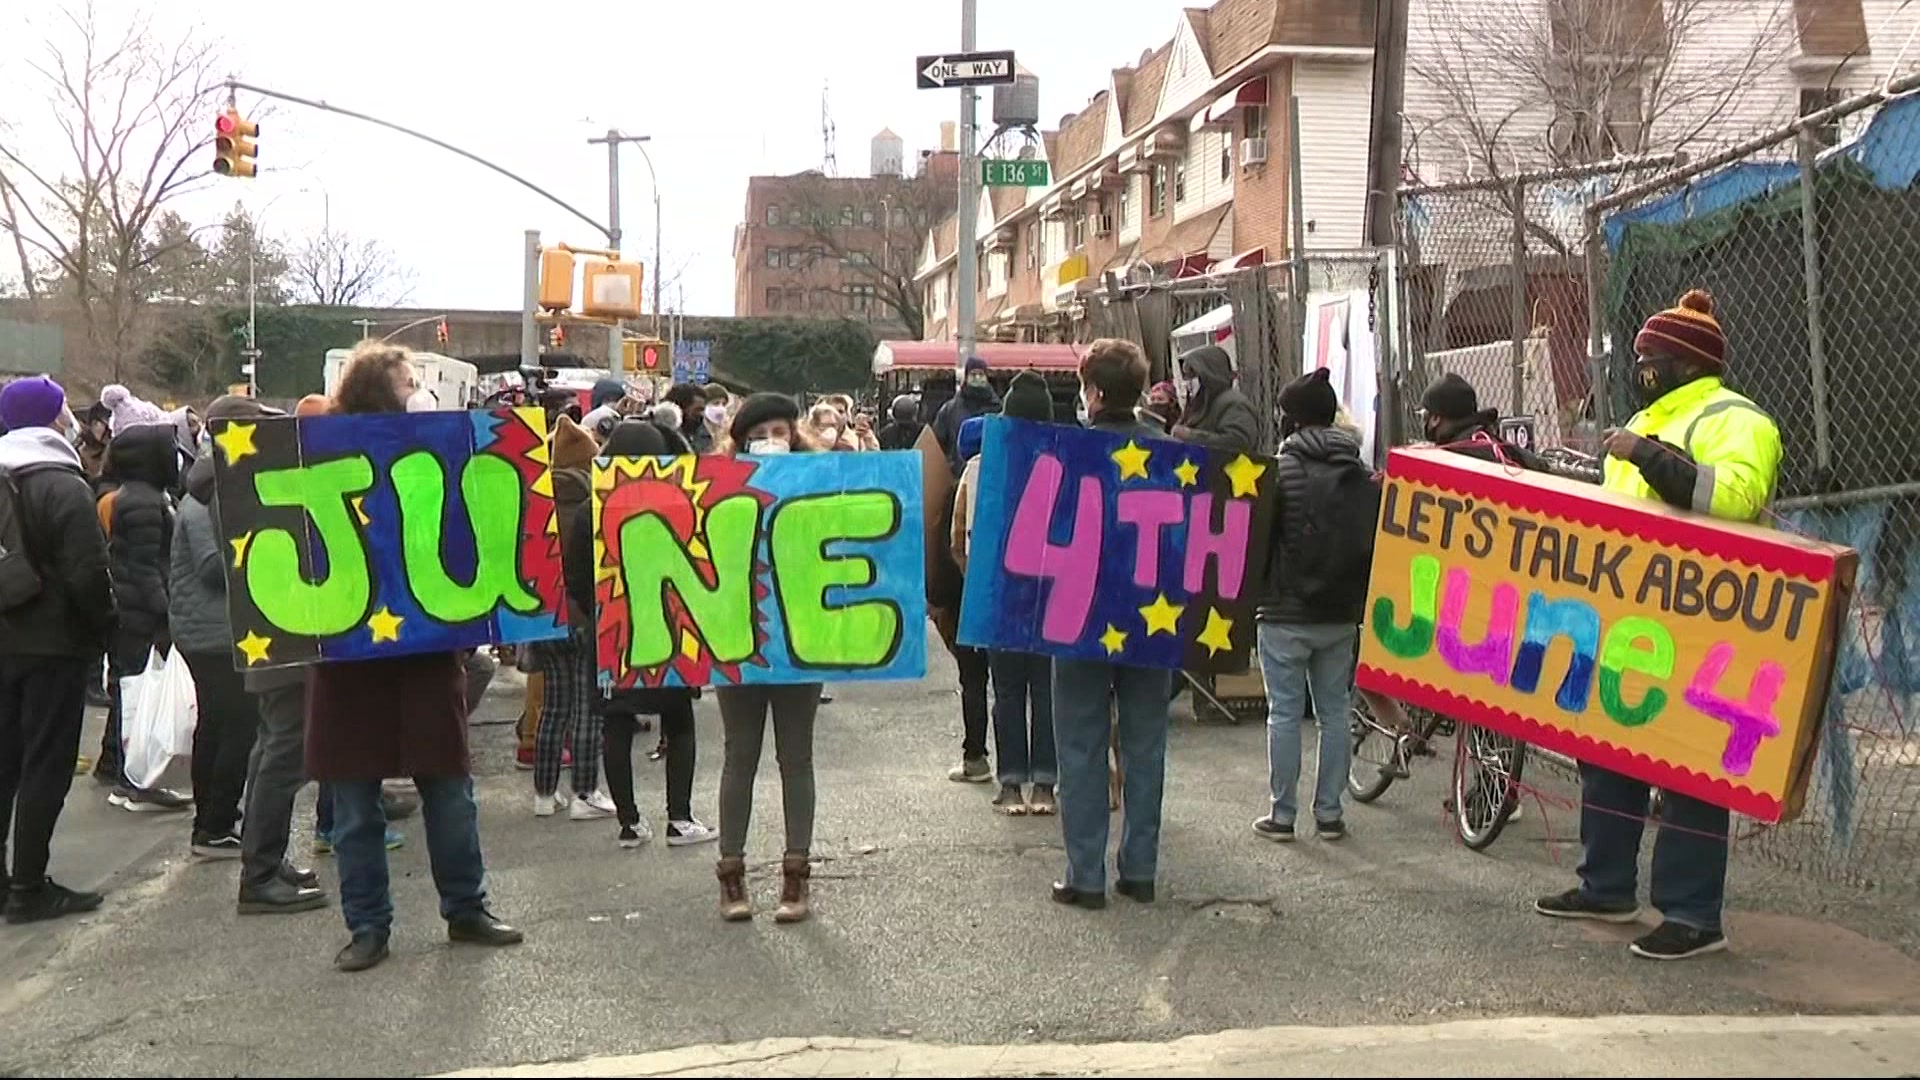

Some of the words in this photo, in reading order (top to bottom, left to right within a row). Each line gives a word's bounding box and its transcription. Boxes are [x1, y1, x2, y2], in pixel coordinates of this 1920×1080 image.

[931, 63, 959, 78] ONE
[972, 60, 1002, 75] WAY
[986, 164, 993, 182] E
[1002, 164, 1025, 182] 136
[246, 450, 543, 637] JU
[618, 489, 902, 671] NE
[1004, 453, 1251, 645] 4TH
[1381, 483, 1499, 558] LET'S
[1508, 516, 1632, 599] TALK
[1635, 553, 1819, 641] ABOUT
[1684, 641, 1785, 777] 4
